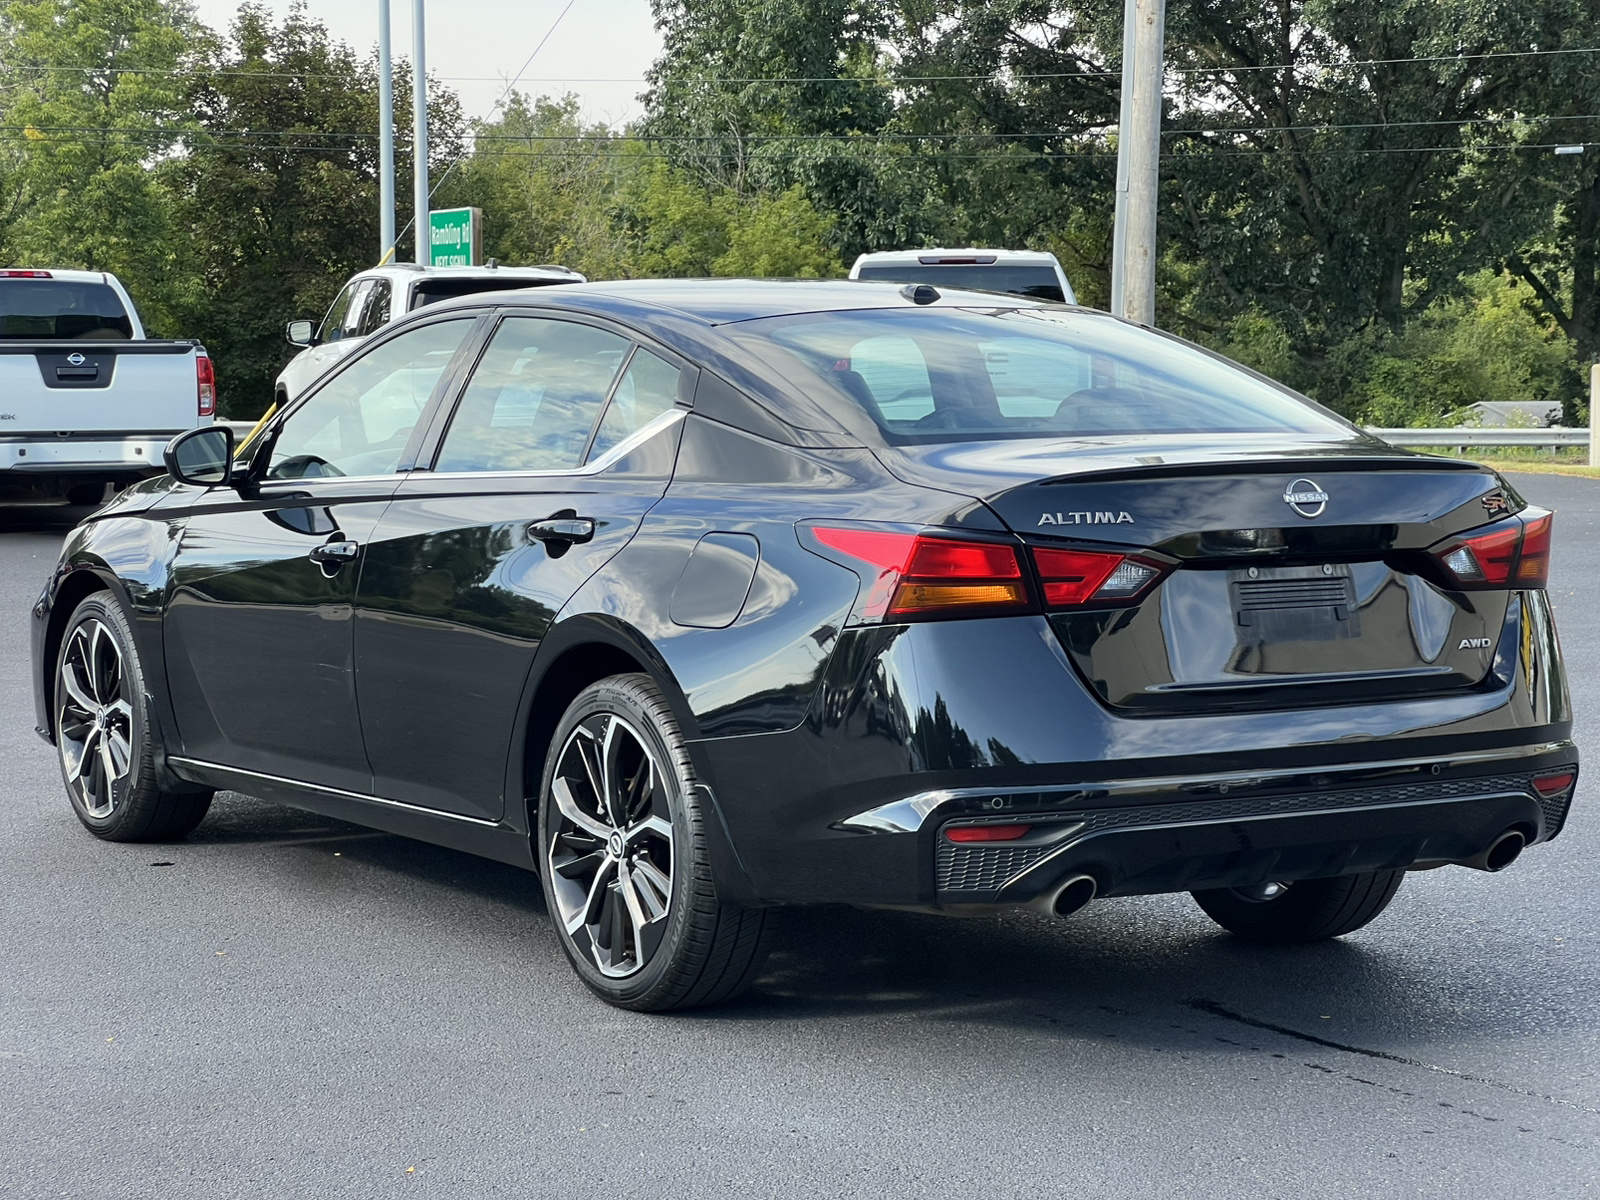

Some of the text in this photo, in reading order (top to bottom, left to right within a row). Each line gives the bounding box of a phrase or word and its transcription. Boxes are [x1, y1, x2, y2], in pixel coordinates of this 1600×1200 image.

[432, 221, 469, 249] Rambling Rd
[1285, 493, 1329, 502] NISSAN
[1037, 511, 1135, 526] ALTIMA
[1458, 638, 1491, 650] AWD
